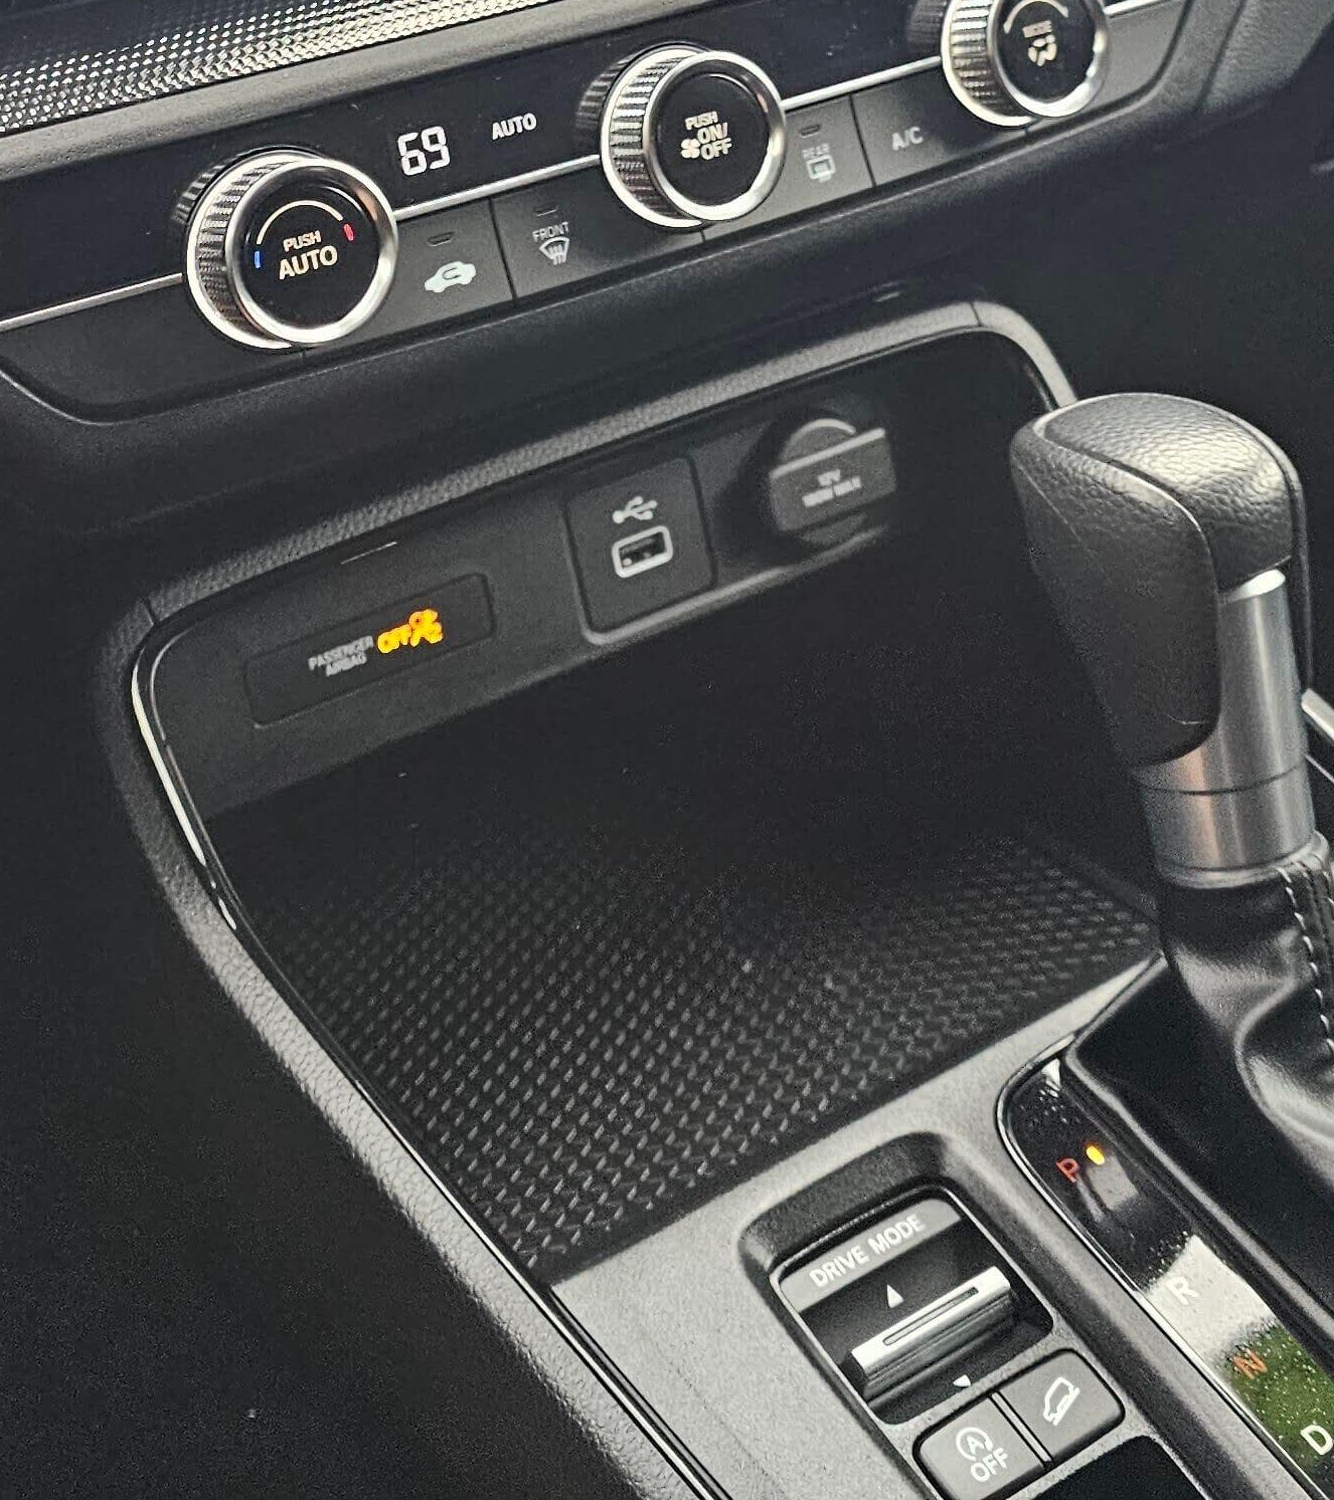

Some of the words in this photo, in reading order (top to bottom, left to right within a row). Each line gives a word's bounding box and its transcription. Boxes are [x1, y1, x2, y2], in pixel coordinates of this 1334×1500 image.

[492, 113, 537, 140] AUTO
[684, 111, 720, 130] PUSH
[397, 125, 451, 176] 69
[700, 137, 732, 160] OFF
[891, 126, 923, 151] A/C
[282, 229, 322, 252] PUSH
[532, 221, 570, 243] FRONT
[278, 244, 338, 280] AUTO
[1055, 1157, 1080, 1183] P
[809, 1244, 871, 1287] DRIVE
[868, 1213, 927, 1255] MODE
[1165, 1276, 1199, 1306] R
[1232, 1348, 1267, 1380] N
[1300, 1424, 1334, 1456] D
[969, 1446, 1009, 1484] OFF
